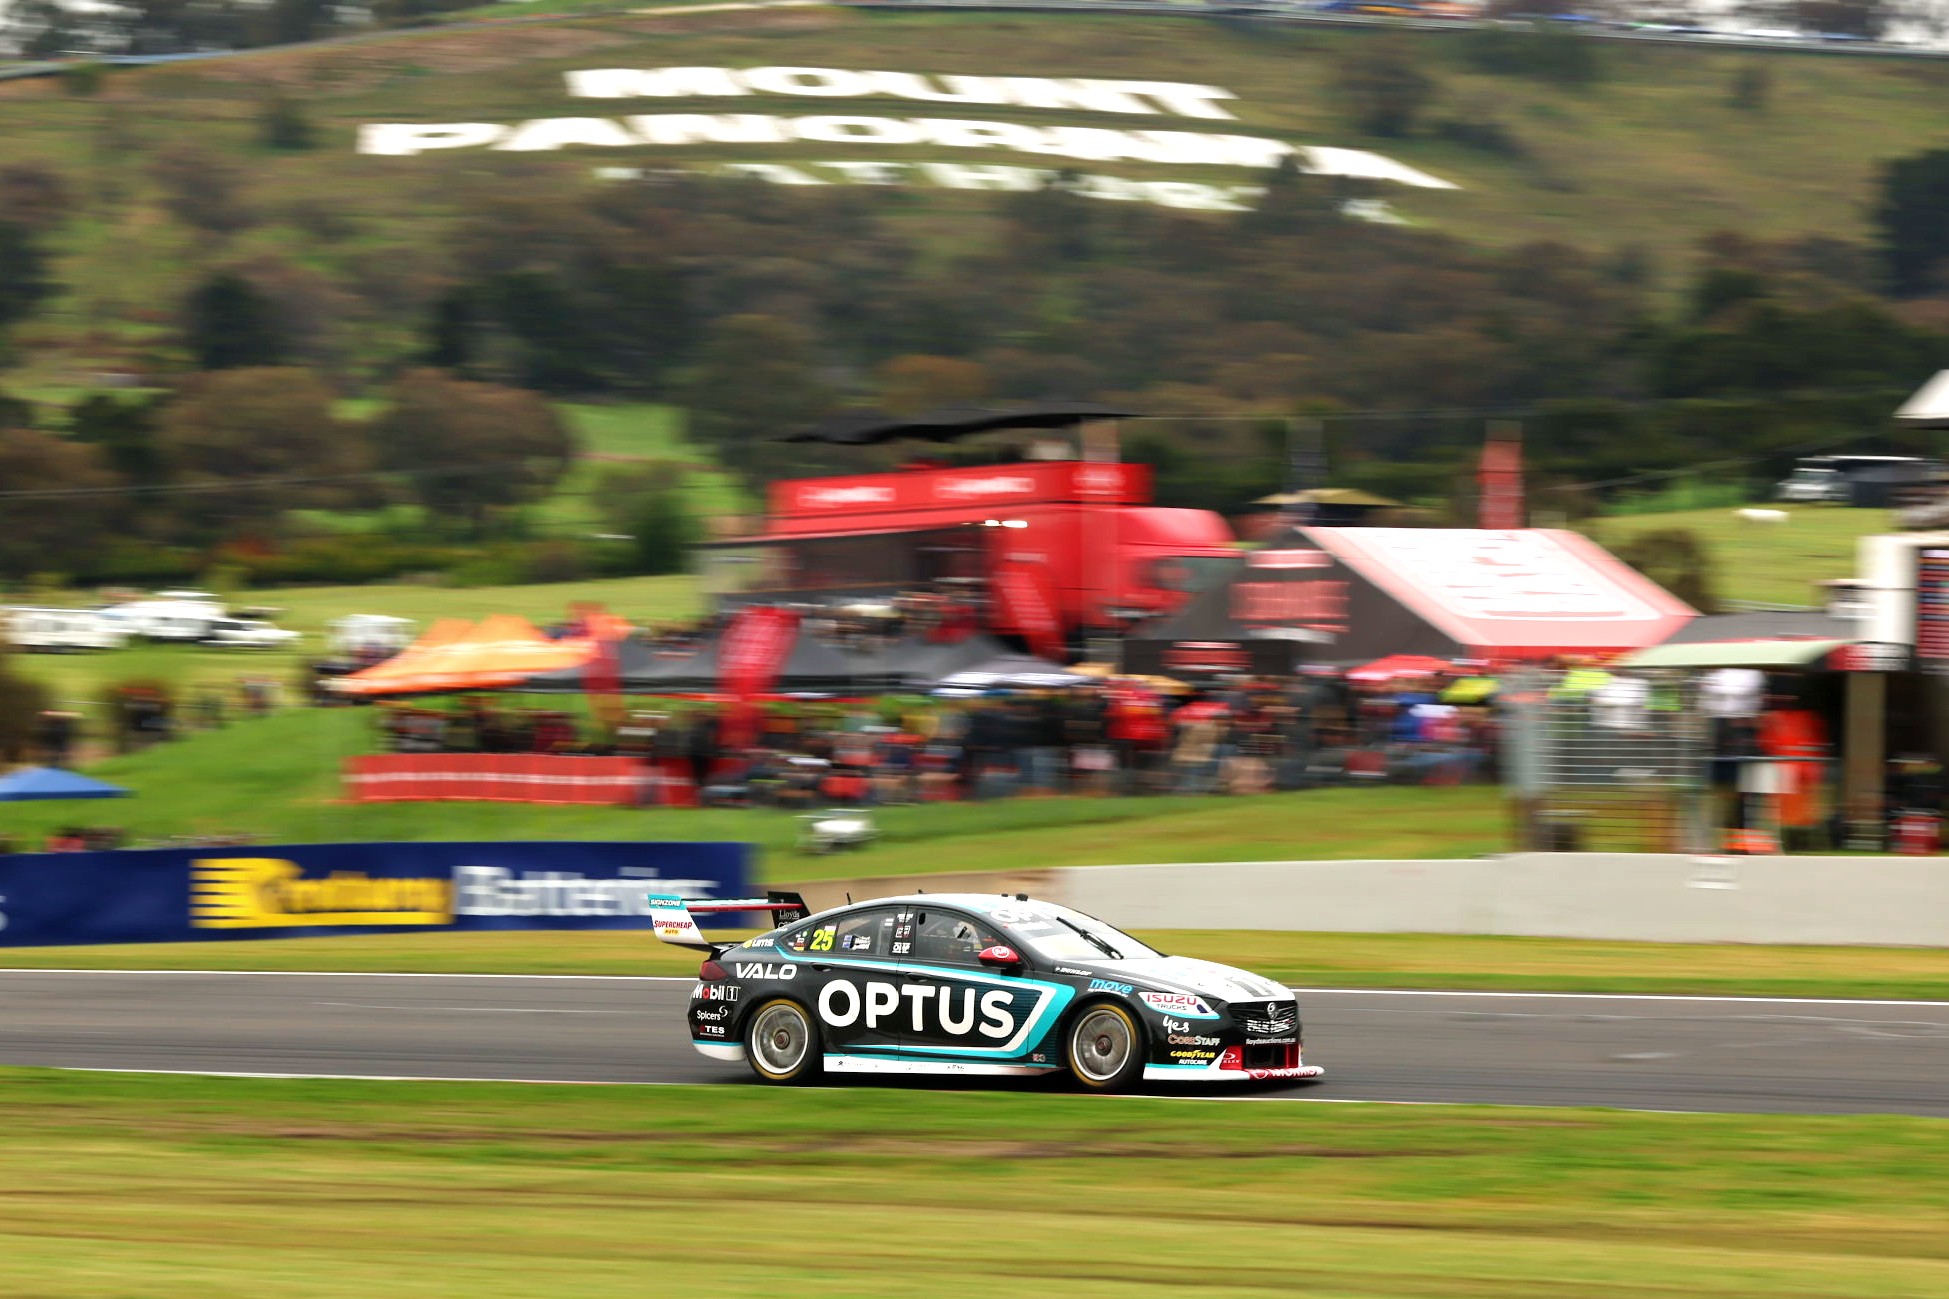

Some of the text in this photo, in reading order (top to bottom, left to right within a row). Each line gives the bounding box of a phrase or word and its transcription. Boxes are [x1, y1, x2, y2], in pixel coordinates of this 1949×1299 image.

[564, 66, 1240, 120] MOUNT
[356, 114, 1460, 190] PANORAMA
[654, 920, 692, 929] SUPERCHEAP
[810, 929, 835, 951] 25
[735, 963, 797, 980] VALO
[692, 984, 725, 1000] Mobil
[1089, 978, 1133, 994] move
[1147, 994, 1197, 1006] ISUZU
[1157, 1003, 1187, 1011] TRUCKS
[697, 1009, 721, 1021] Spicers
[818, 979, 1014, 1038] OPTUS
[705, 1025, 724, 1034] TES
[1170, 1050, 1215, 1059] GOODYEAR
